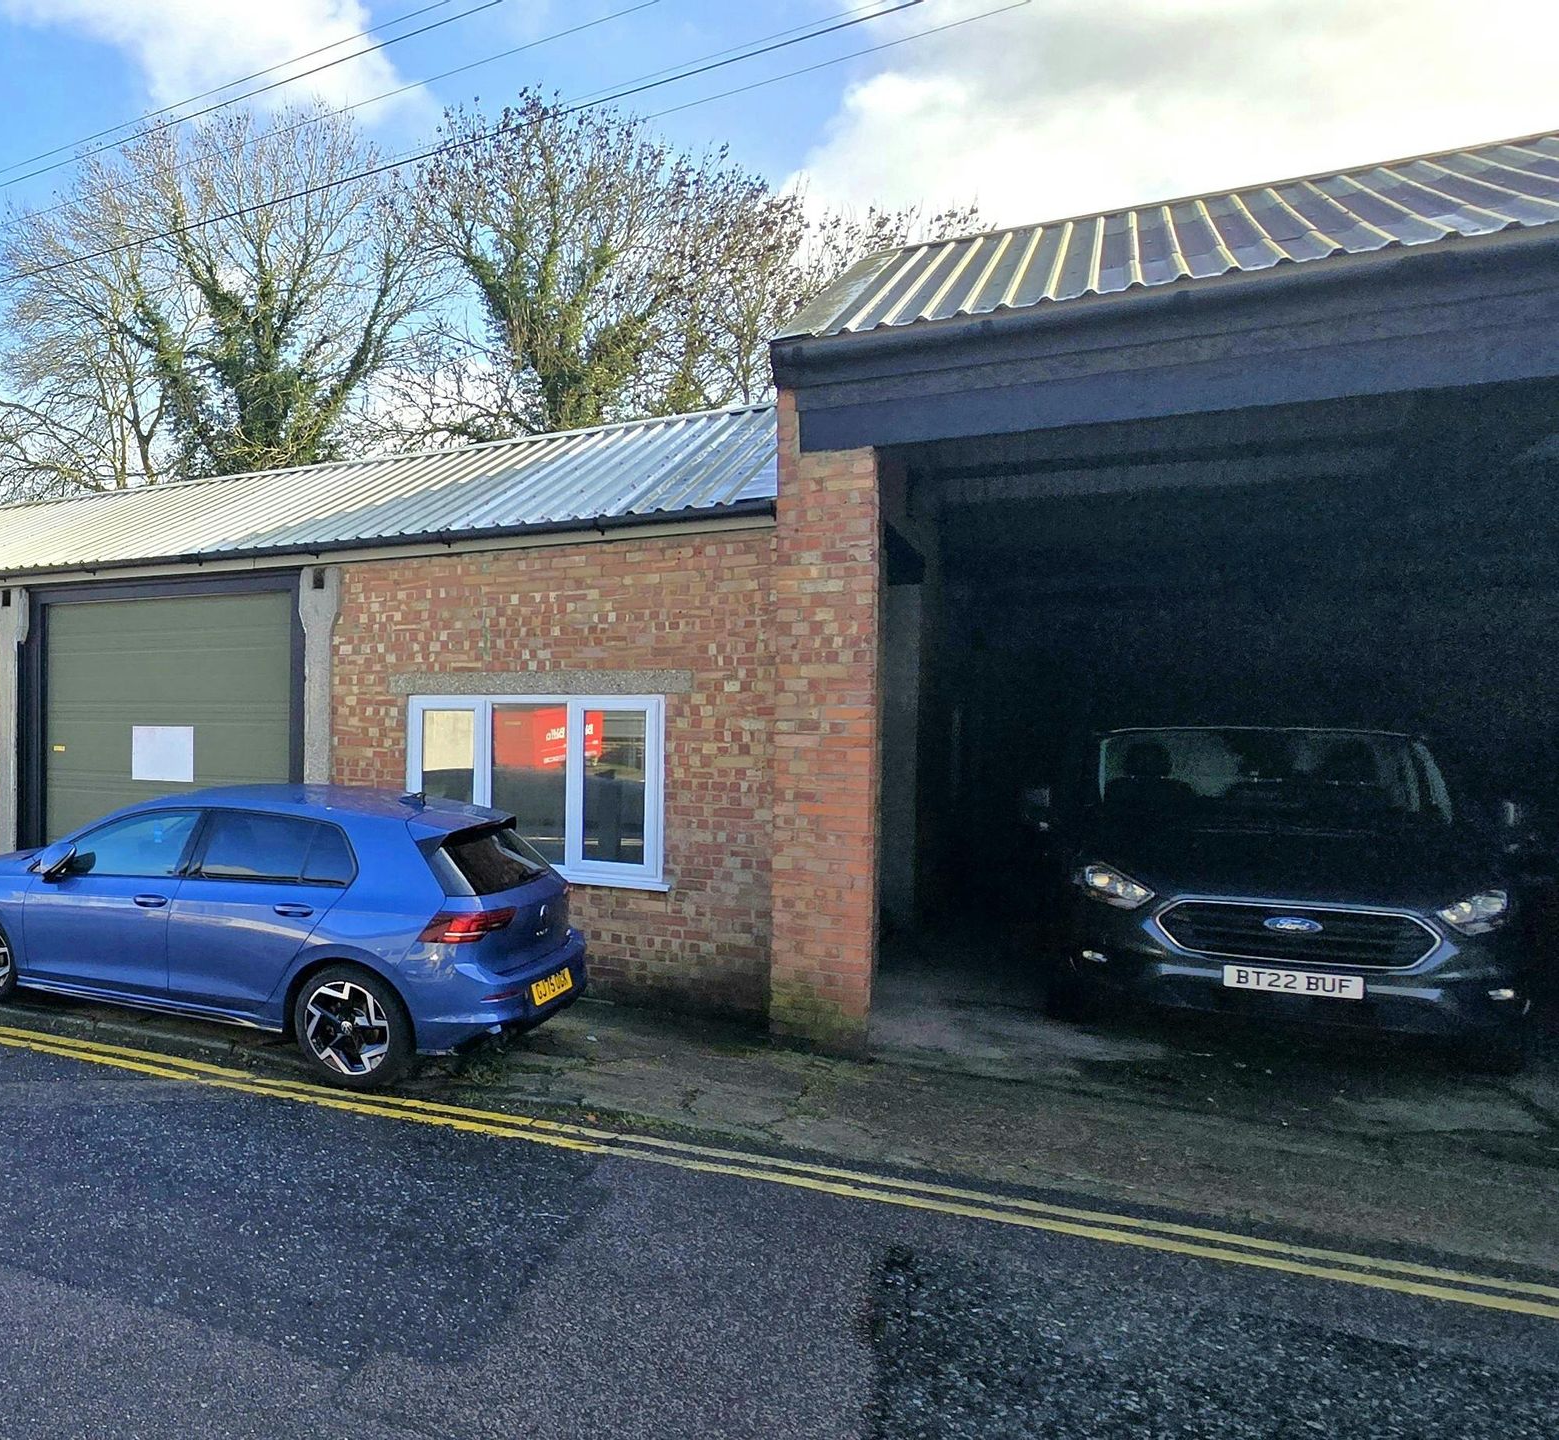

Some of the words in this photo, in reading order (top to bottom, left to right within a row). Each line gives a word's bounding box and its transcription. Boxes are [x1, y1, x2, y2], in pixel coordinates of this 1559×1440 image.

[1276, 918, 1311, 930] Ford
[1236, 969, 1297, 989] BT22
[1305, 975, 1352, 994] BUF
